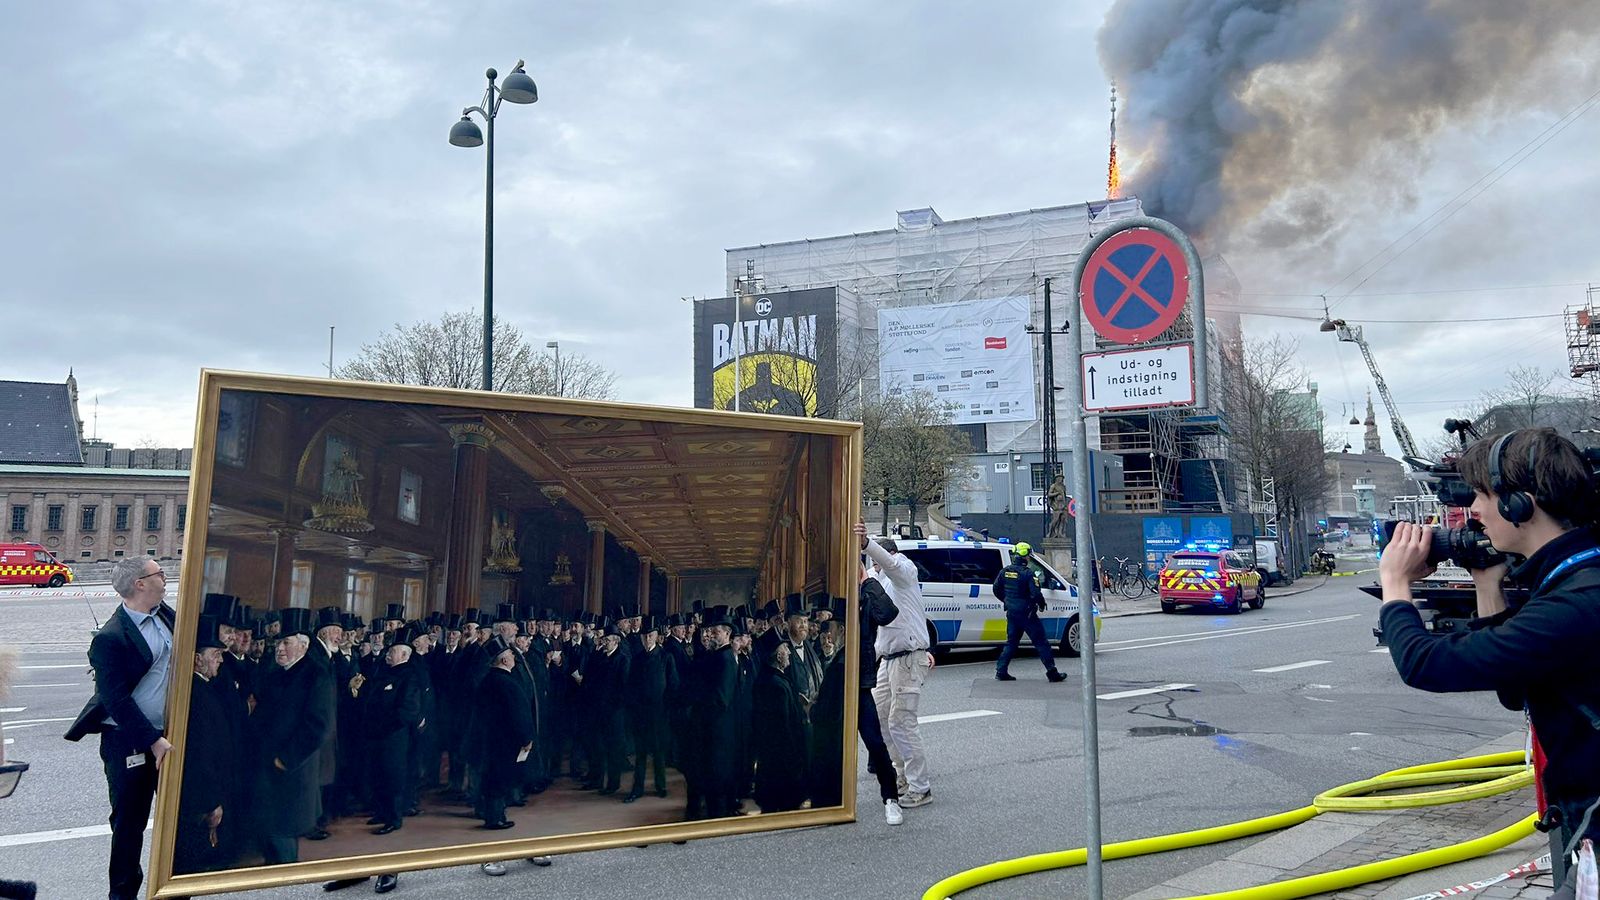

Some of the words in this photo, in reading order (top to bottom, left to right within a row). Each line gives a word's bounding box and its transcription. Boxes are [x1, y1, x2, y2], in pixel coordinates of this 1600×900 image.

[756, 299, 772, 314] DC
[713, 314, 817, 368] BATMAN
[1120, 360, 1141, 370] Ud-
[1148, 358, 1163, 368] og
[1108, 371, 1177, 385] indstigning
[1123, 386, 1162, 398] tilladt
